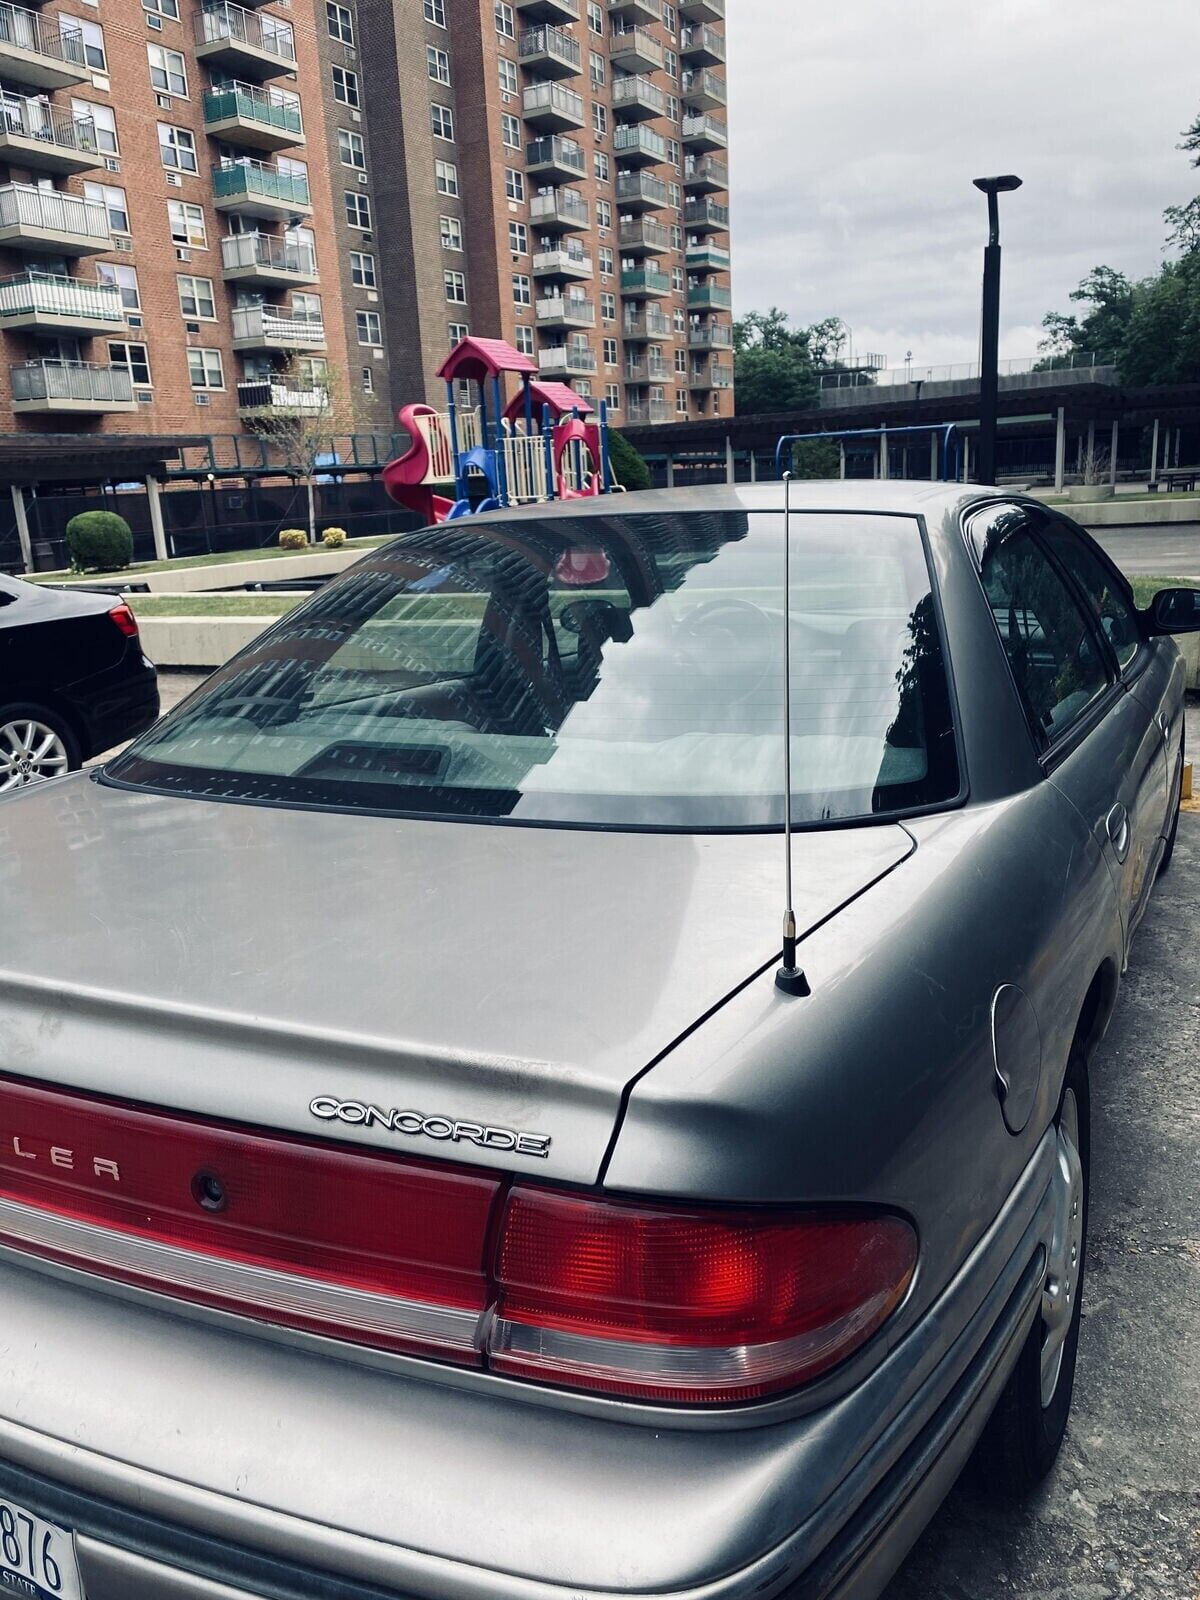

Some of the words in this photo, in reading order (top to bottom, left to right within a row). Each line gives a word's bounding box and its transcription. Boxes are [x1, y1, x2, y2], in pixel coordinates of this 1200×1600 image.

[13, 1137, 121, 1181] LER
[309, 1097, 552, 1159] CONCORDE
[0, 1505, 61, 1590] 876
